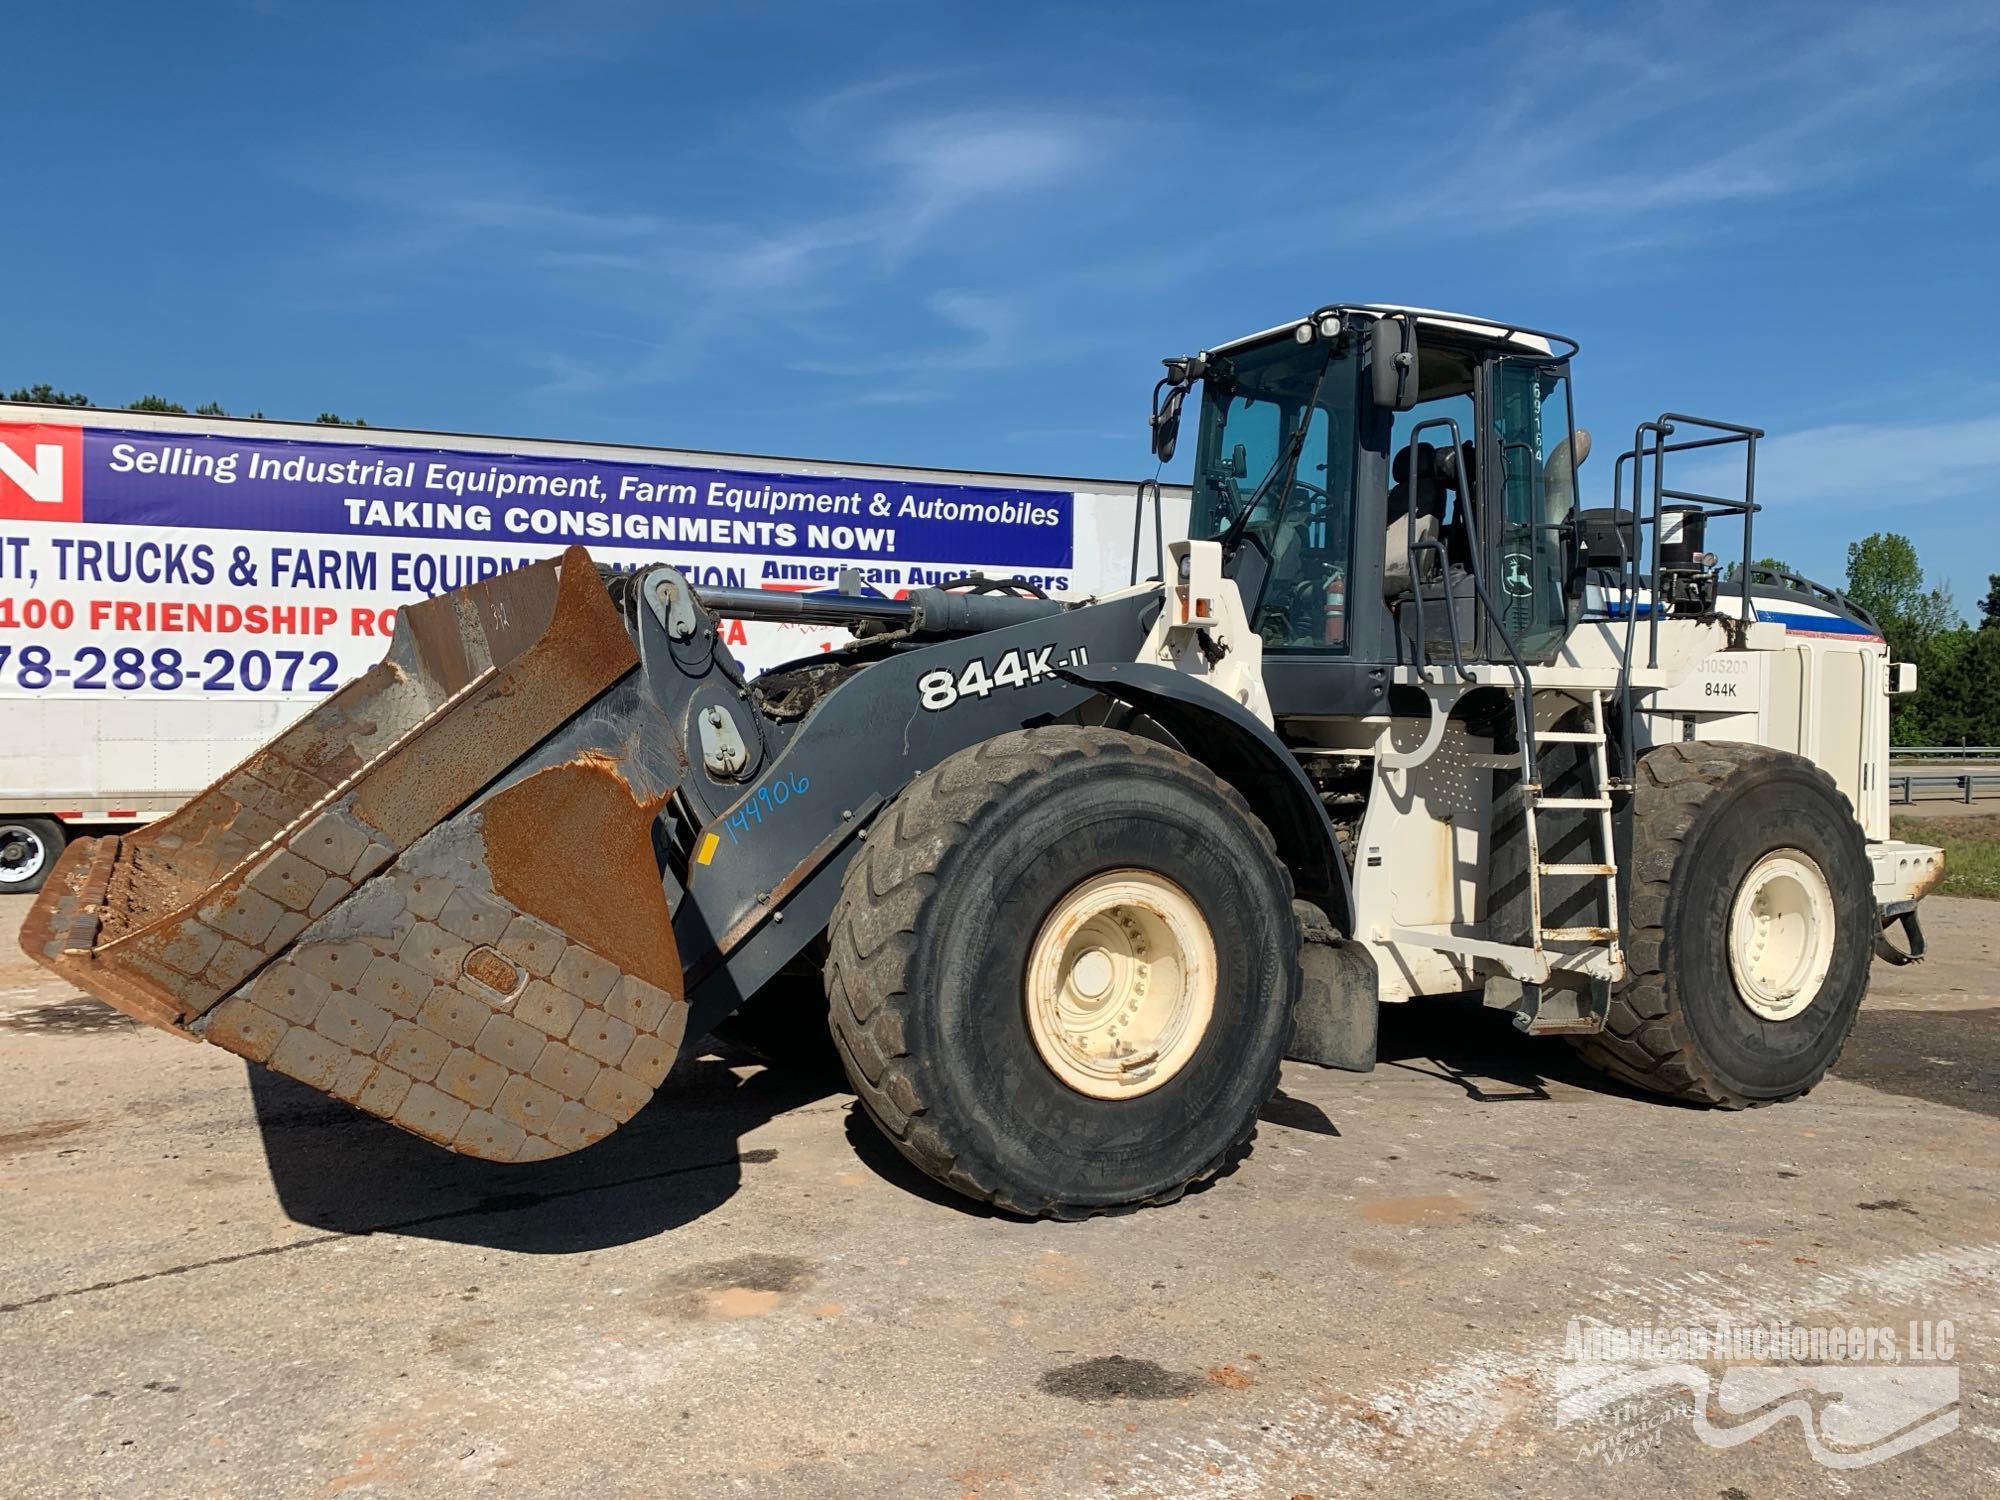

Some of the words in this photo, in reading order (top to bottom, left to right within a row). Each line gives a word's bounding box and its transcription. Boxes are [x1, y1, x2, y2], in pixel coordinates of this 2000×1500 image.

[109, 444, 239, 484] Selling
[248, 453, 415, 488] Industrial
[425, 464, 607, 504] Equipment,
[619, 476, 697, 505] Farm
[707, 482, 862, 516] Equipment
[868, 492, 892, 518] &
[897, 495, 1060, 527] Automobiles
[344, 499, 492, 531] TAKING
[504, 507, 798, 547] CONSIGNMENTS
[807, 524, 896, 553] NOW!
[52, 538, 215, 586] TRUCKS
[228, 545, 258, 588] &
[271, 548, 377, 591] FARM
[90, 600, 338, 635] FRIENDSHIP
[351, 608, 398, 637] RO
[917, 642, 1090, 713] 844K-II
[1704, 682, 1737, 697] 844K
[723, 771, 810, 846] 144906
